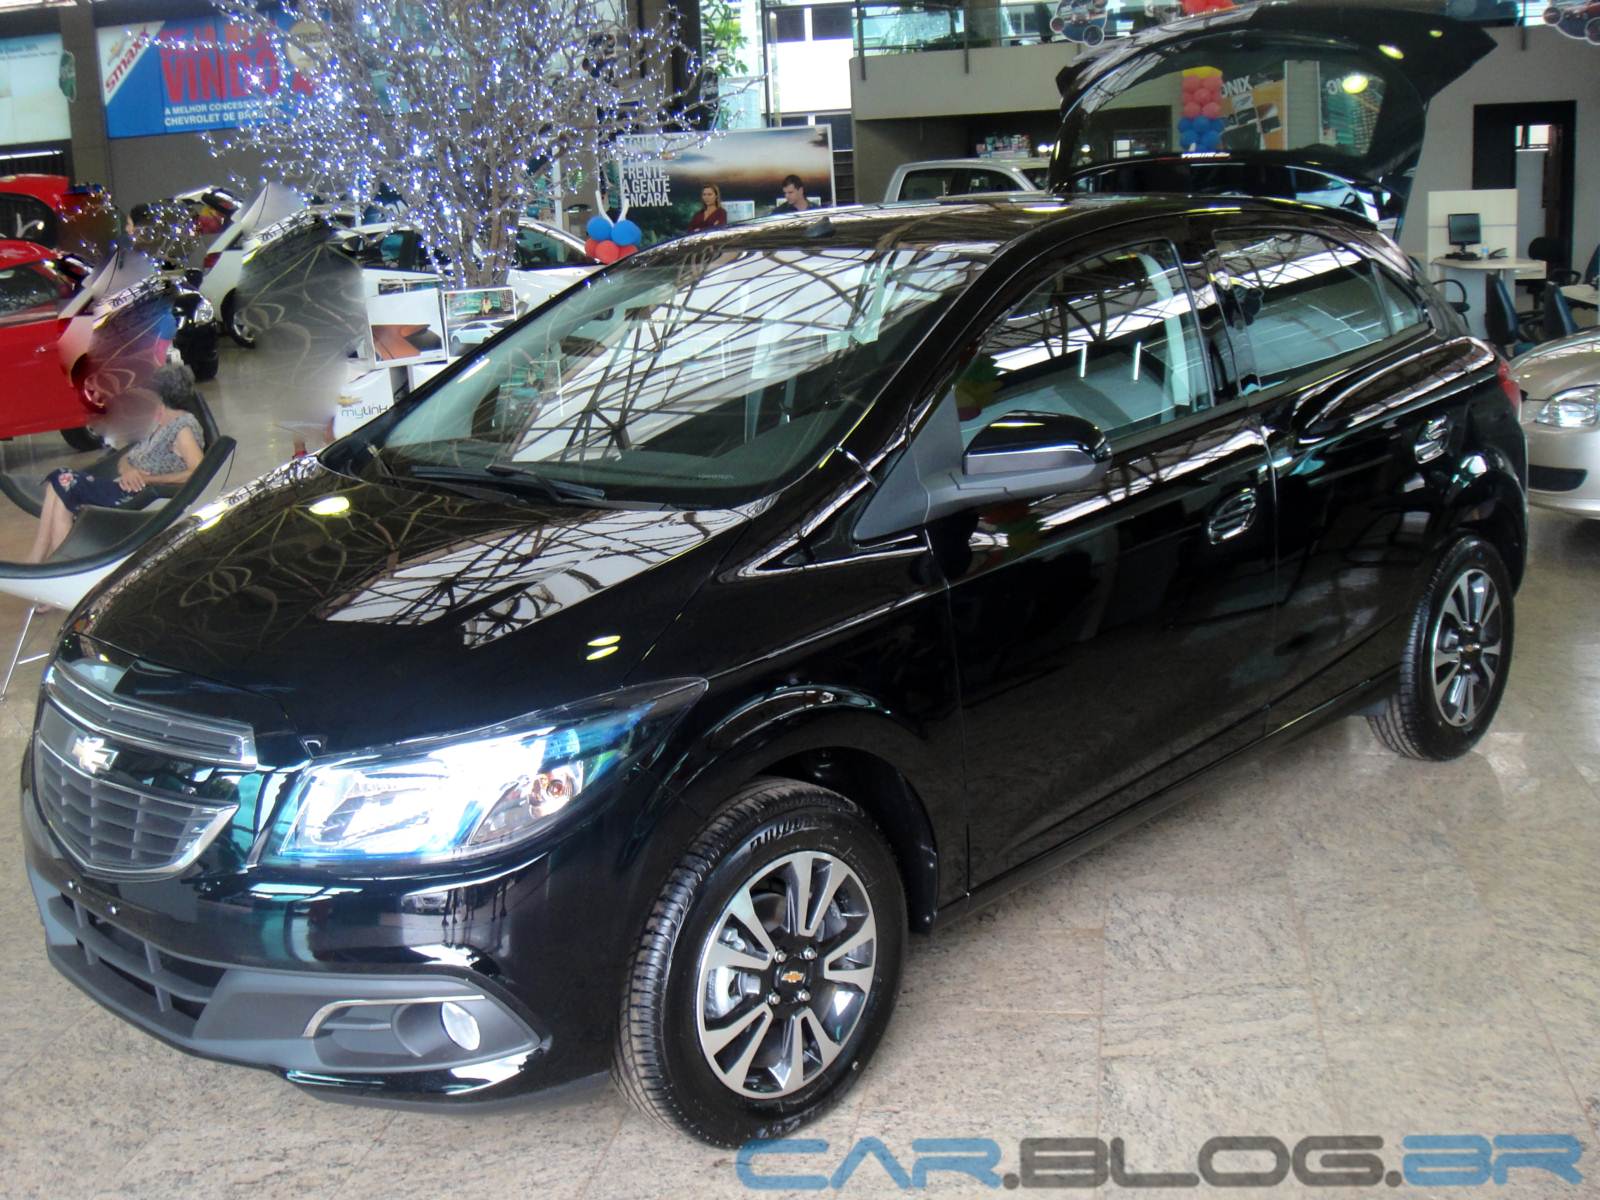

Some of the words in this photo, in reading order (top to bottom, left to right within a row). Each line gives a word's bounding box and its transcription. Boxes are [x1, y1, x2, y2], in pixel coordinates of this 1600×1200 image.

[165, 107, 171, 115] A
[172, 104, 208, 114] MELHOR
[164, 113, 220, 126] CHEVROLET
[223, 111, 236, 121] DE
[622, 180, 631, 194] A
[632, 178, 671, 194] GENTE
[622, 192, 673, 207] ENCARA.
